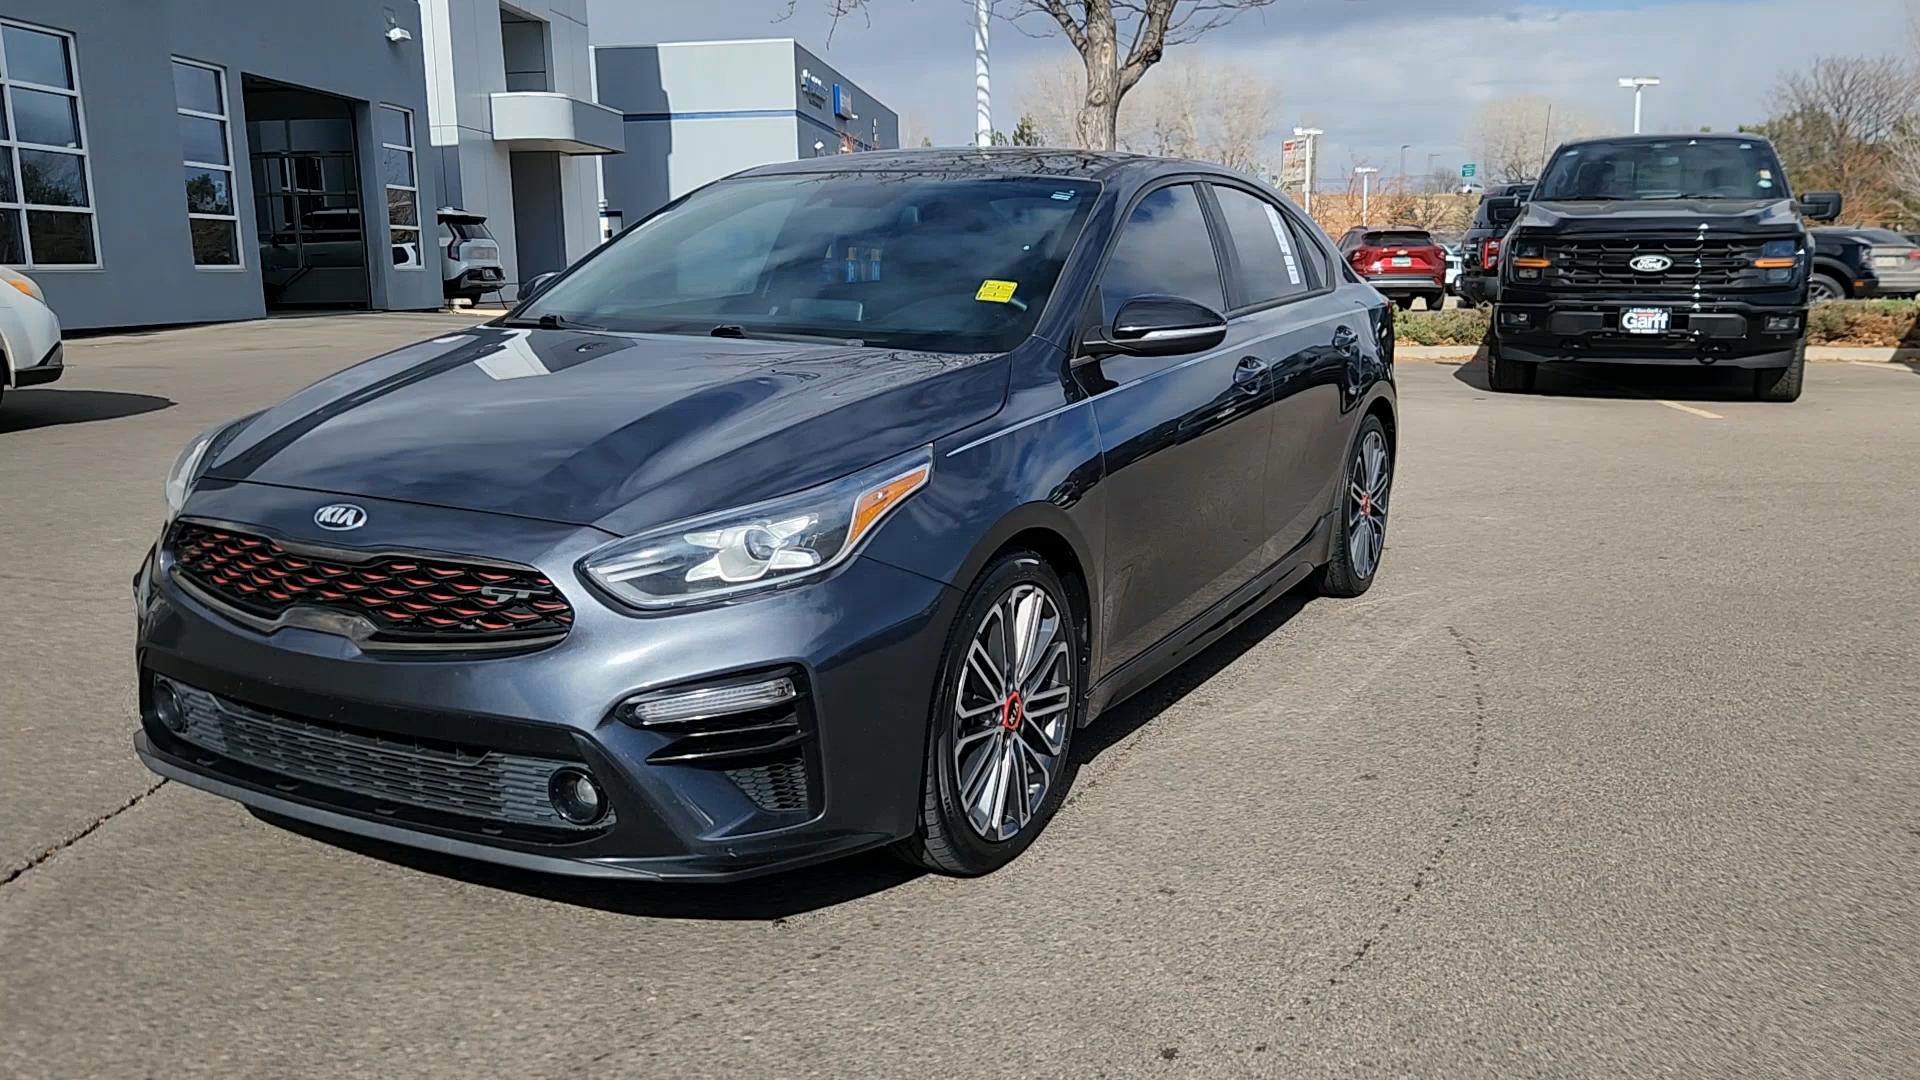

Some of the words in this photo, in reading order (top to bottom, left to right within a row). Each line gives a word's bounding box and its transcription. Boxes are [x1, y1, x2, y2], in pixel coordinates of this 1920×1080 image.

[1622, 312, 1669, 329] Garff
[317, 505, 358, 526] KIA
[481, 586, 552, 603] GT
[1008, 702, 1020, 725] KIA
